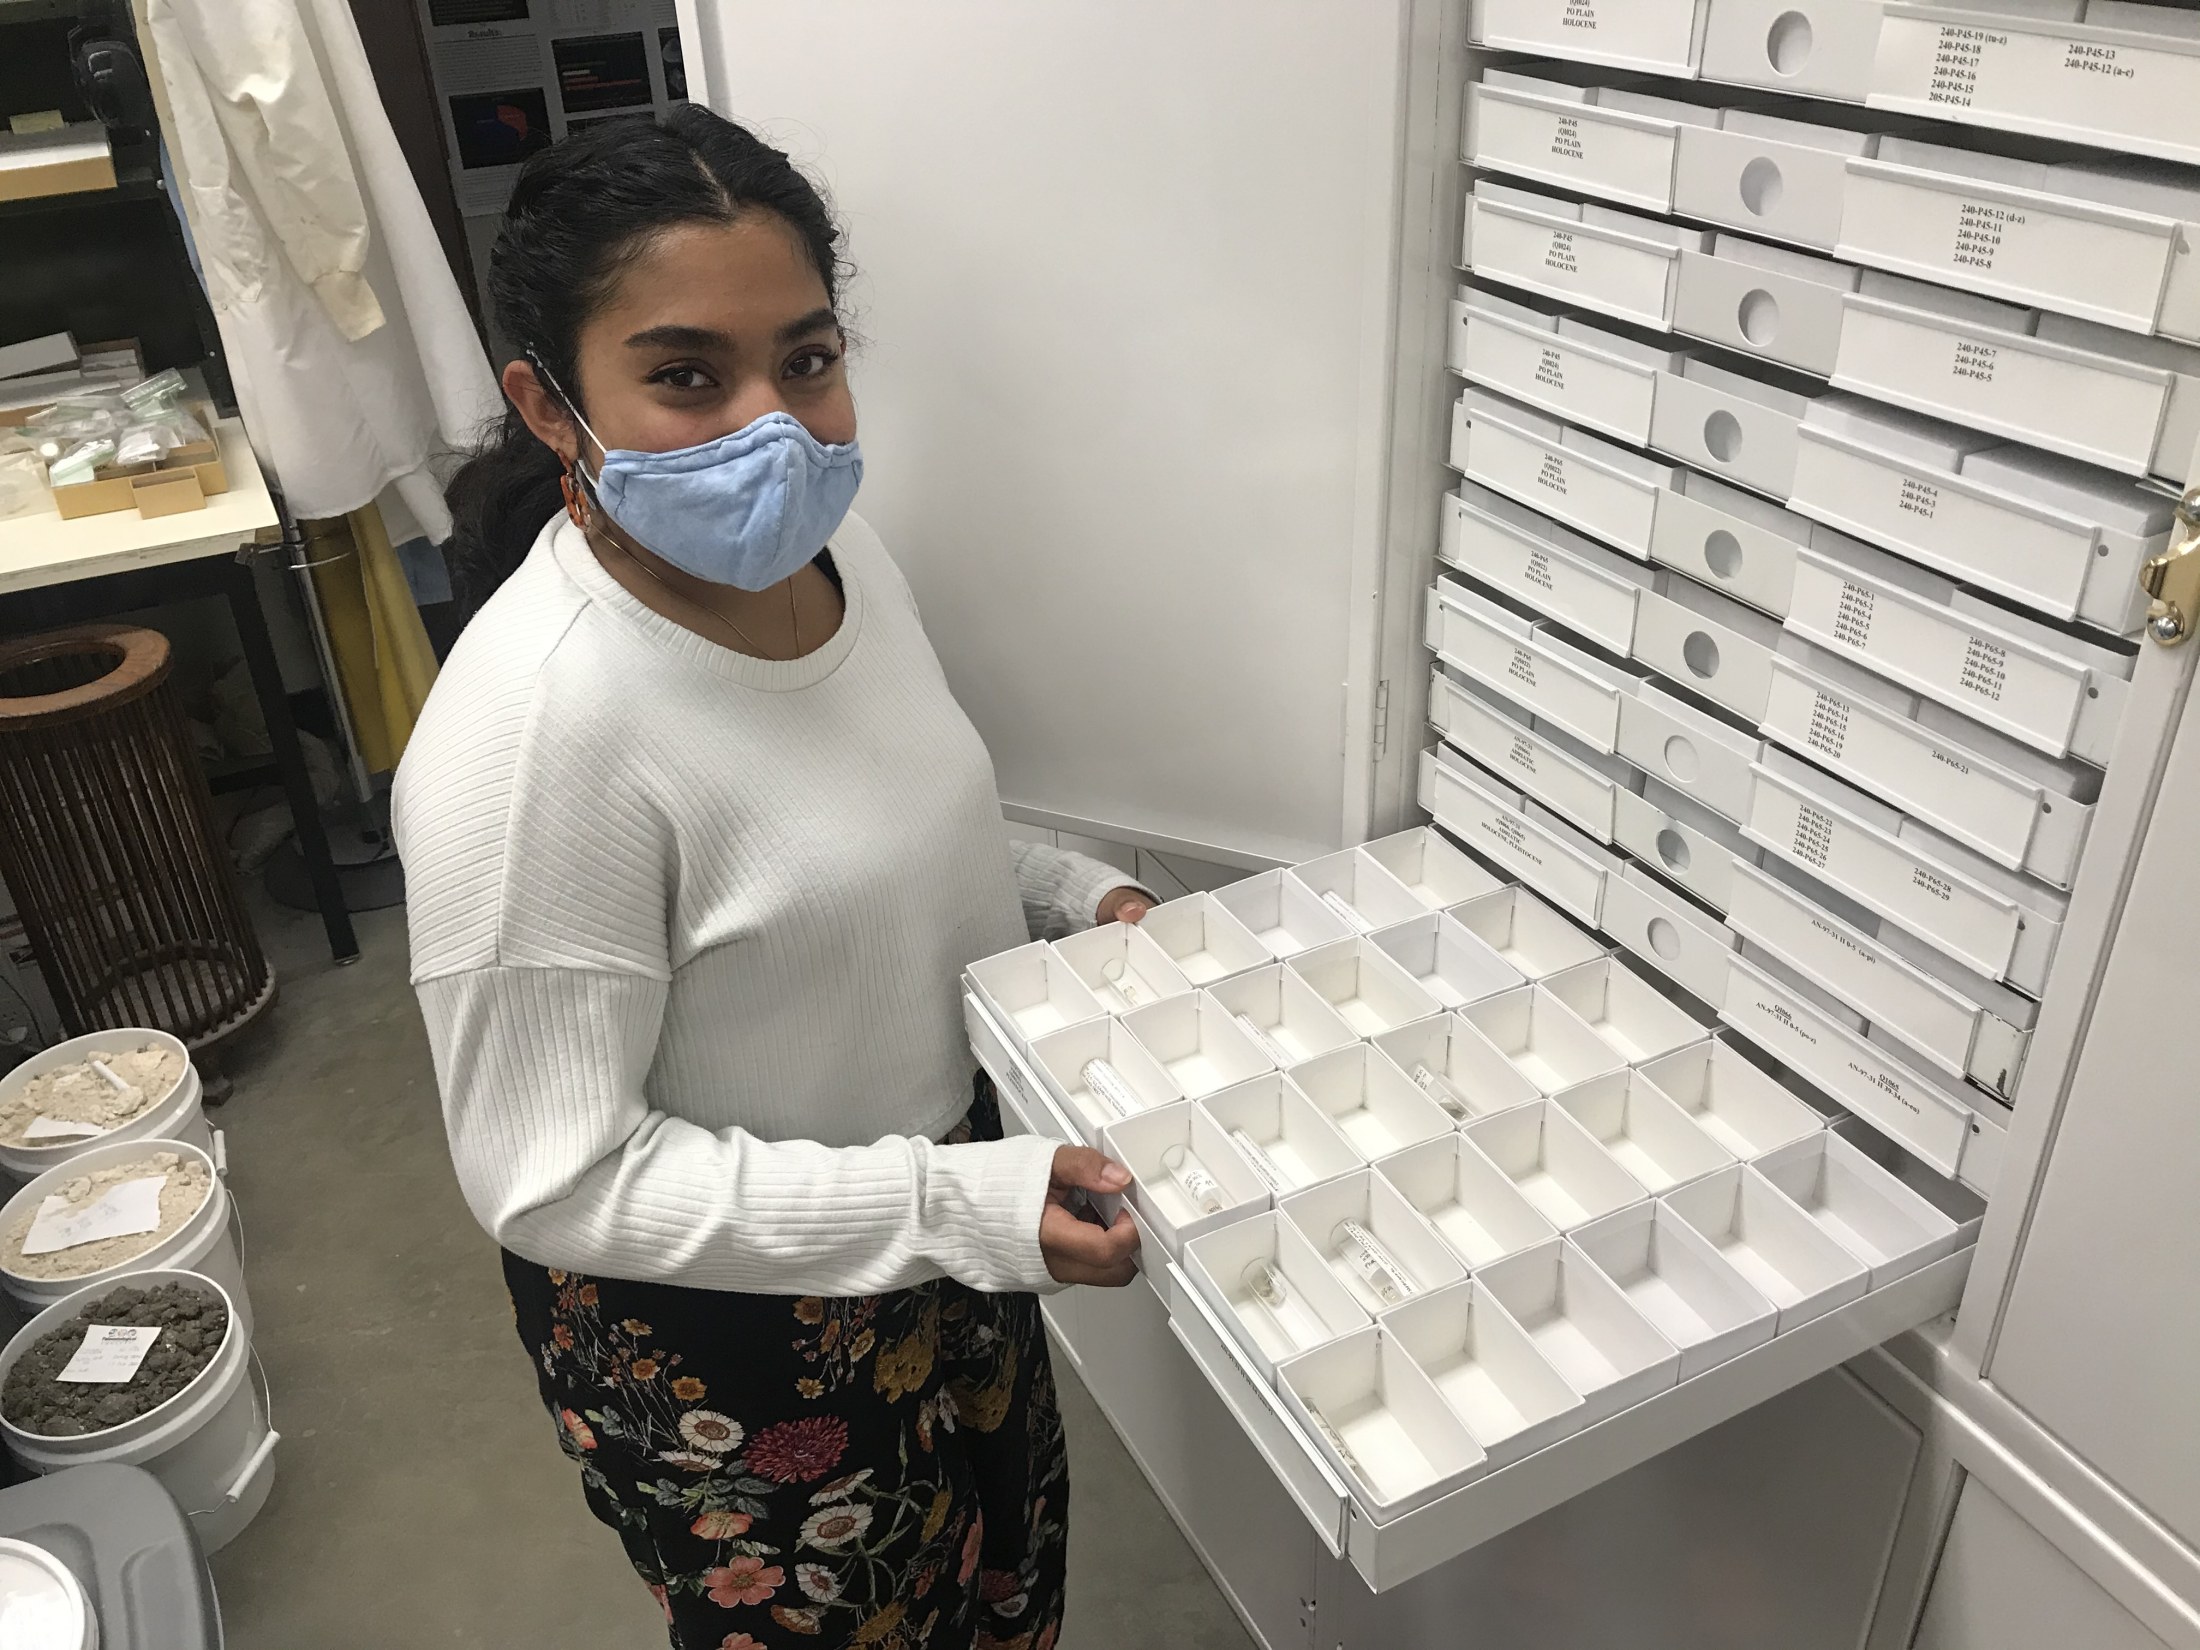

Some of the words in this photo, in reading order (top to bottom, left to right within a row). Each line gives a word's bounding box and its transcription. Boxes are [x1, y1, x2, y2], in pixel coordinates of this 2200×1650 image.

[1566, 7, 1574, 15] PO
[1576, 8, 1594, 18] PLAIN
[1562, 18, 1596, 30] HOLOCENE
[1940, 26, 1984, 42] 240-P45-19
[1938, 40, 1982, 54] 240-P45-18
[2068, 44, 2116, 60] 240-P45-13
[1936, 52, 1980, 67] 240-P45-17
[2064, 58, 2112, 74] 240-P45-12
[1933, 66, 1976, 80] 240-P45-16
[1931, 78, 1974, 94] 240-P45-15
[1554, 136, 1563, 144] PO
[1564, 138, 1581, 148] PLAIN
[1552, 145, 1584, 160] HOLOCENE
[1961, 204, 2004, 220] 240-P45-12
[1959, 216, 2002, 232] 240-P45-11
[1957, 228, 2001, 245] 240-P45-10
[1558, 252, 1576, 262] PLAIN
[1955, 241, 1994, 256] 240-P45-9
[1545, 258, 1578, 273] HOLOCENE
[1953, 253, 1992, 269] 240-P45-8
[1957, 342, 1997, 358] 240-P45-7
[1955, 353, 1994, 370] 240-P45-6
[1535, 373, 1564, 390] HOLOCENE
[1539, 365, 1546, 373] PO
[1546, 368, 1563, 380] PLAIN
[1952, 365, 1992, 382] 240-P45-5
[1537, 476, 1568, 495] HOLOCENE
[1541, 469, 1549, 477] PO
[1550, 472, 1566, 485] PLAIN
[1903, 478, 1938, 497] 240-P45-4
[1901, 489, 1936, 508] 240-P45-3
[1899, 500, 1934, 519] 240-P45-1
[1524, 571, 1553, 591] HOLOCENE
[1536, 569, 1551, 581] PLAIN
[1843, 581, 1875, 601] 240-P65-1
[1839, 601, 1872, 620] 240-P65-4
[1841, 591, 1873, 611] 240-P65-2
[1835, 620, 1868, 640] 240-P65-6
[1837, 611, 1870, 630] 240-P65-5
[1834, 630, 1866, 650] 240-P65-7
[1969, 636, 2006, 658] 240-P65-8
[1967, 646, 2004, 668] 240-P65-9
[1508, 667, 1537, 688] HOLOCENE
[1965, 657, 2006, 680] 240-P65-10
[1962, 667, 2002, 691] 240-P65-11
[1960, 677, 2000, 702] 240-P65-12
[1814, 700, 1848, 723] 240-P65-14
[1816, 691, 1850, 713] 240-P65-13
[1811, 718, 1845, 741] 240-P65-16
[1812, 710, 1847, 732] 240-P65-15
[1808, 736, 1840, 759] 240-P65-20
[1809, 727, 1843, 750] 240-P65-19
[1932, 750, 1969, 775] 240-P65-21
[1798, 812, 1832, 835] 240-P65-23
[1800, 804, 1833, 827] 240-P65-22
[1795, 830, 1829, 852] 240-P65-25
[1797, 821, 1830, 844] 240-P65-24
[1508, 840, 1543, 865] PLEISTOCENE
[1792, 846, 1825, 869] 240-P65-27
[1794, 838, 1827, 861] 240-P65-26
[1912, 876, 1950, 901] 240-P65-29
[1914, 867, 1952, 892] 240-P65-28
[1811, 919, 1838, 940] AN-97-31
[1846, 942, 1856, 951] 0-5
[1756, 1002, 1782, 1022] AN-97-31
[1790, 1023, 1799, 1032] 0-5
[1848, 1062, 1876, 1084] AN-97-31
